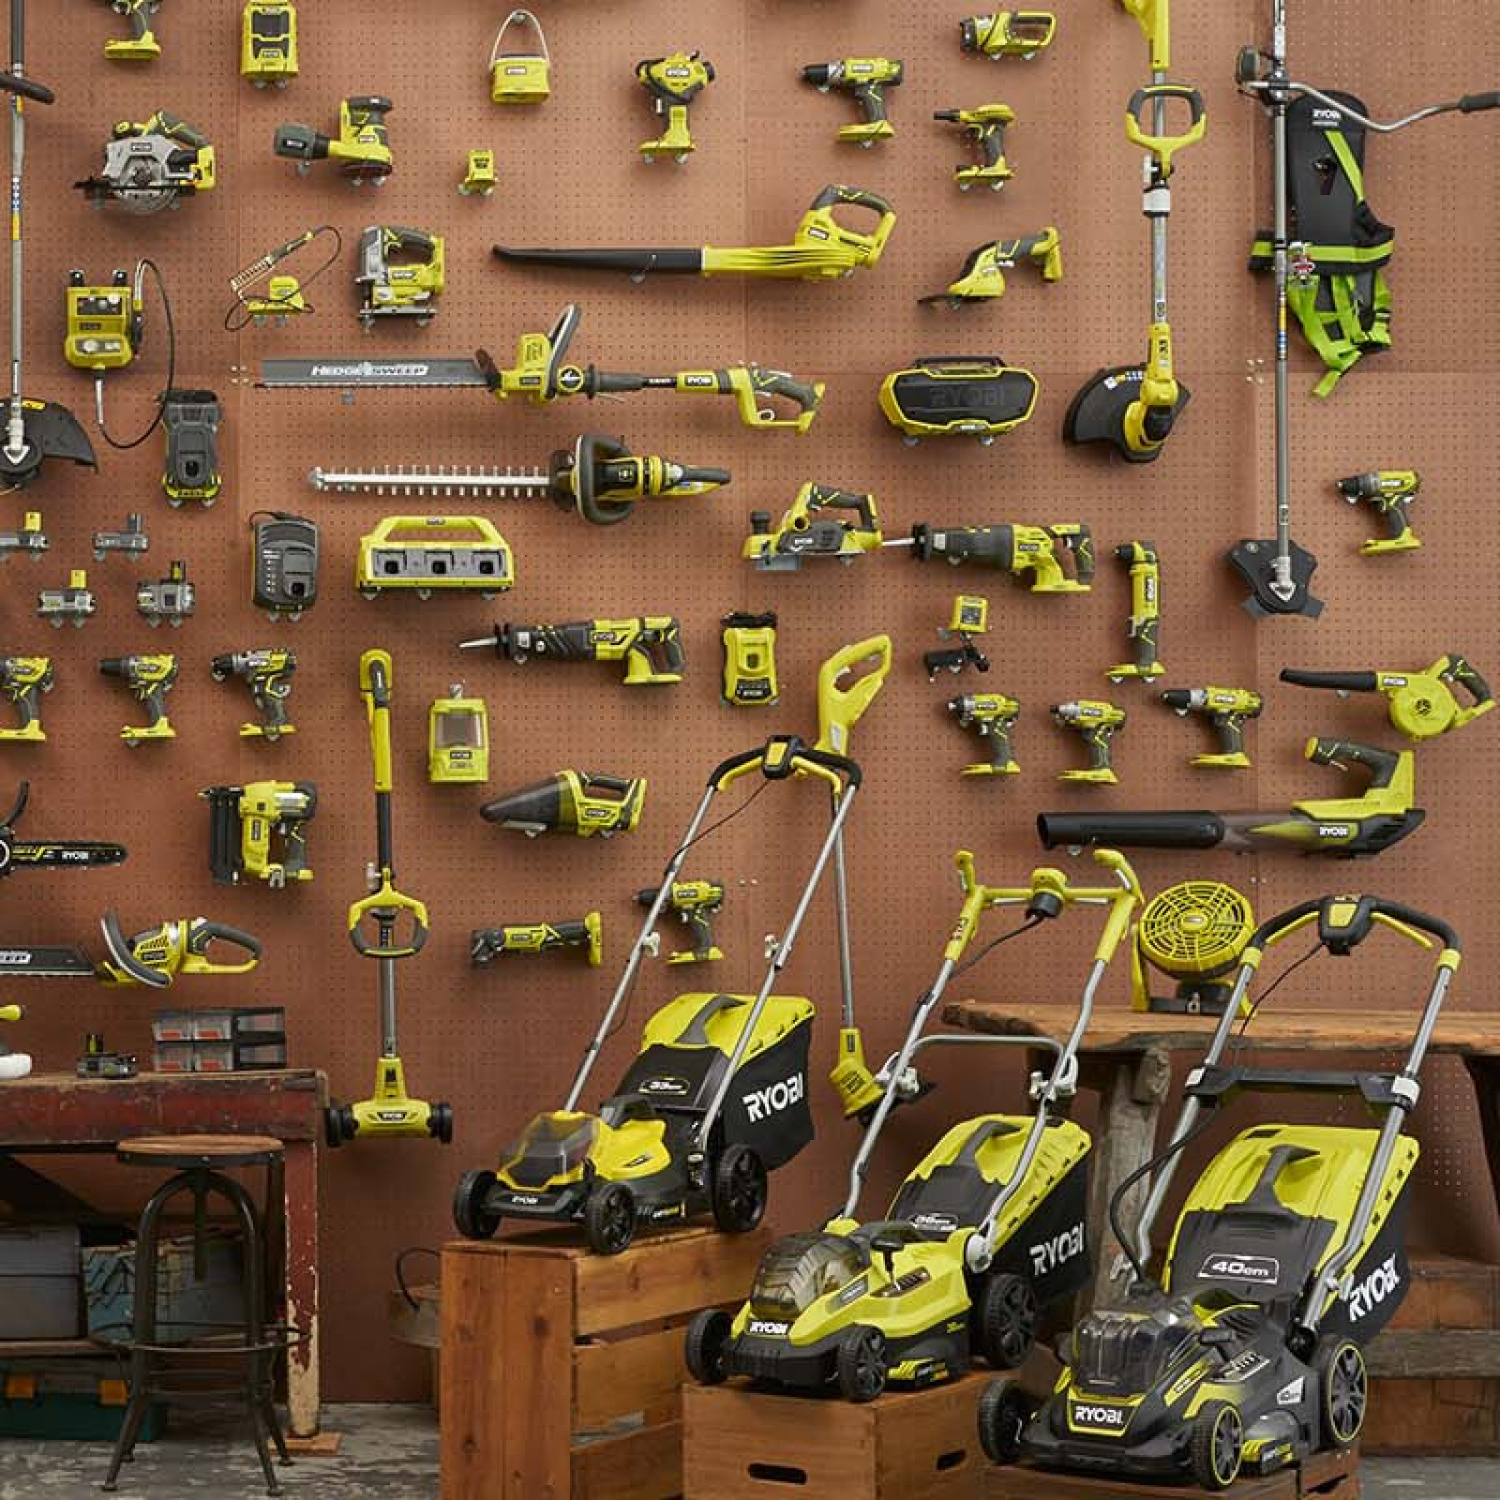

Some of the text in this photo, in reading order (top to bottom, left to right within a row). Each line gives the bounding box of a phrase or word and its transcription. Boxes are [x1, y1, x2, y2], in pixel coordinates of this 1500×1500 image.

[742, 1072, 803, 1122] RYOBI
[1029, 1221, 1084, 1275] RYOBI
[1212, 1260, 1269, 1276] 40cm
[1348, 1253, 1400, 1322] RYOBI
[749, 1320, 788, 1334] RYOBI
[1075, 1405, 1122, 1425] RYOBI
